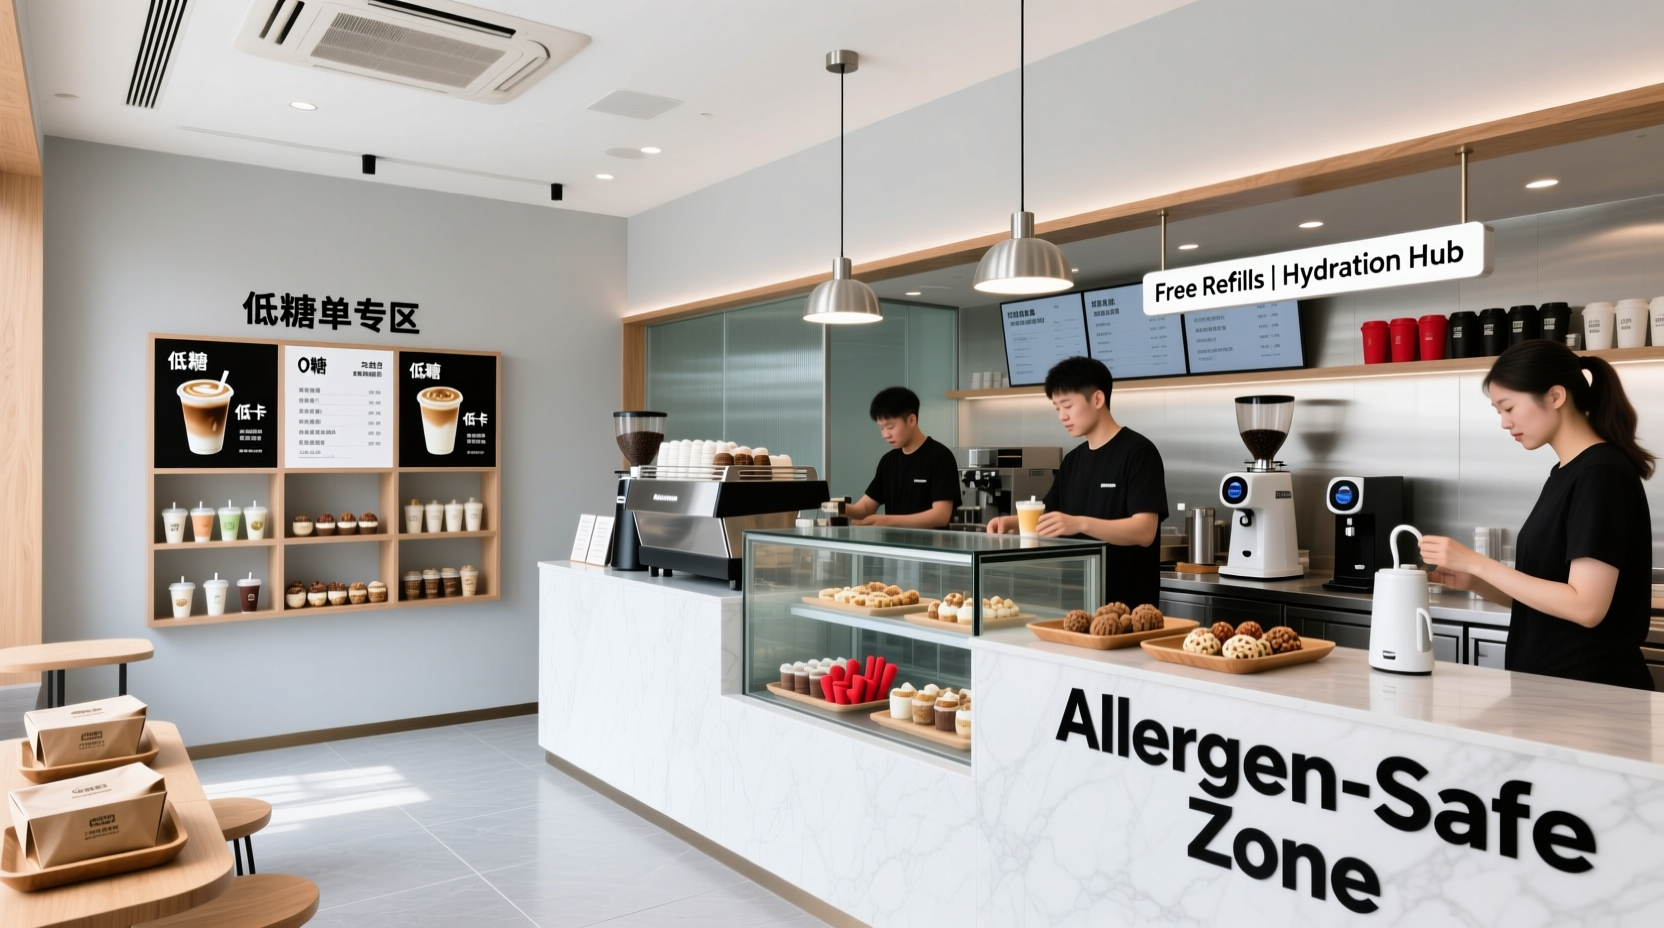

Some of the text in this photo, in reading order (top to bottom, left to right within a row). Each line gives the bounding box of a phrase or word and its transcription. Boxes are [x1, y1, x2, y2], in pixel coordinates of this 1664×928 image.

[1155, 281, 1198, 303] Free
[1203, 269, 1265, 296] Refills
[1283, 251, 1401, 289] Hydration
[1409, 239, 1464, 269] Hub
[242, 290, 421, 335] 低糖单专区
[167, 350, 208, 372] 低糖
[234, 402, 267, 421] 低卡
[1055, 687, 1597, 874] Allergen-Safe
[1187, 796, 1381, 914] Zone
